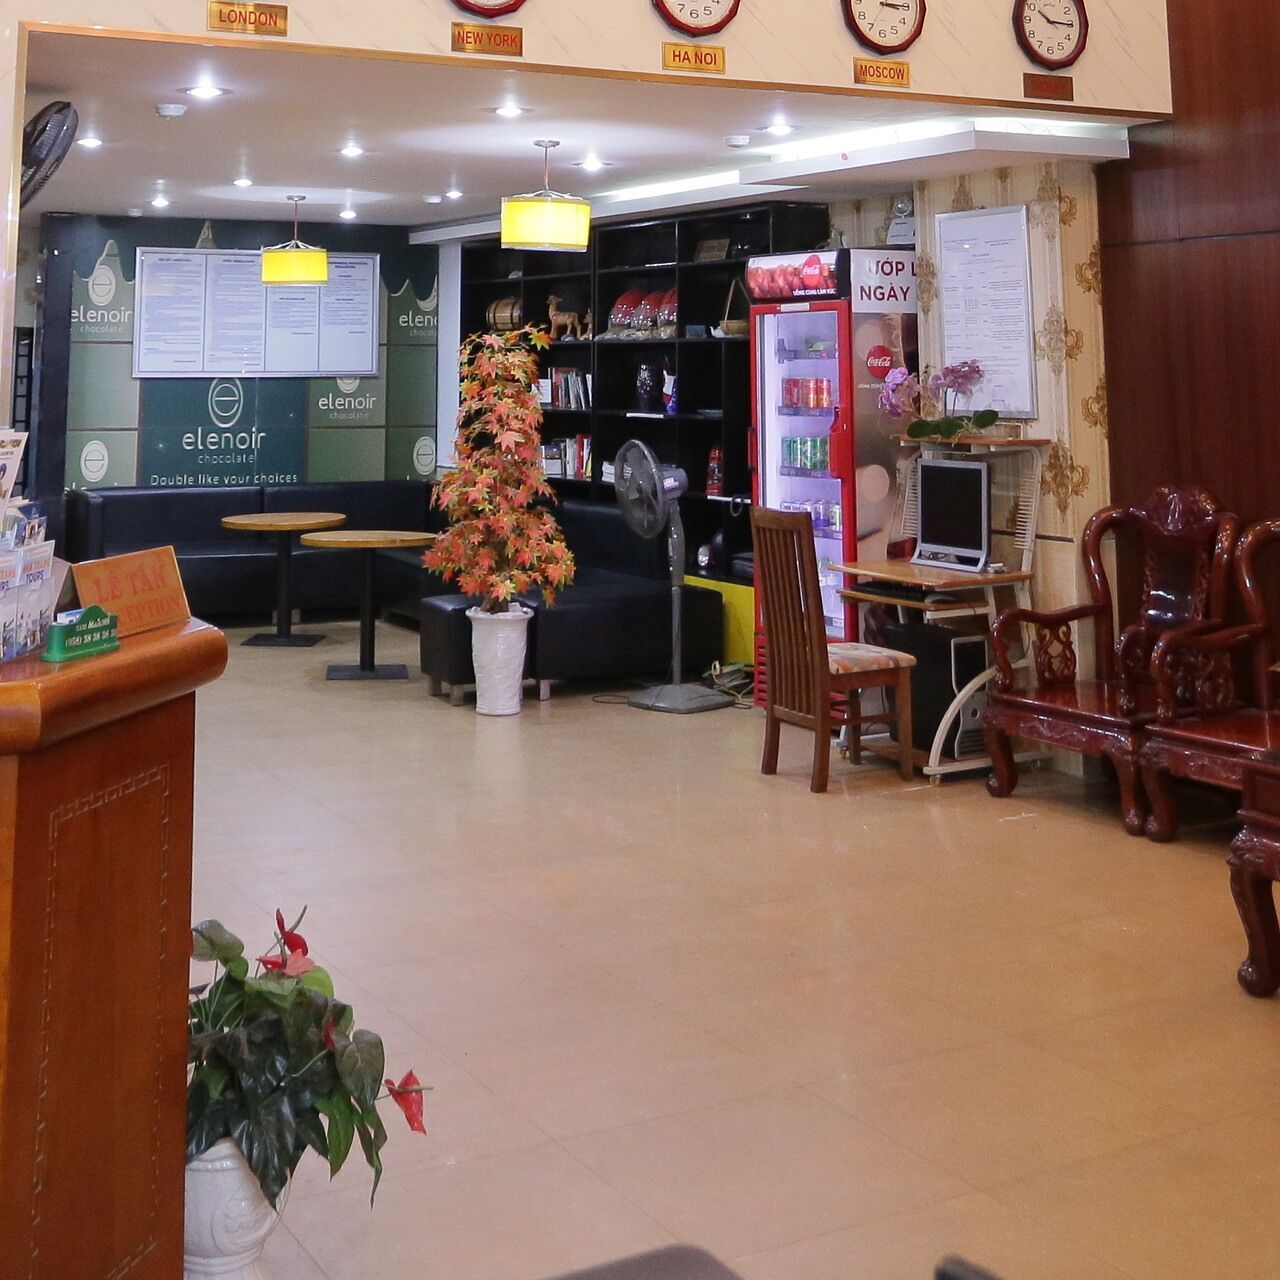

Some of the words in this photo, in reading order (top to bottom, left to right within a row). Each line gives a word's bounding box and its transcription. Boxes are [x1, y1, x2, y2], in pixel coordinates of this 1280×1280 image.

[678, 4, 685, 12] 7
[704, 6, 712, 15] 5
[1027, 3, 1035, 11] 10
[1064, 7, 1070, 15] 2
[219, 9, 278, 27] LONDON
[690, 10, 699, 18] 6
[858, 12, 865, 20] 8
[1024, 15, 1031, 23] 9
[867, 23, 874, 31] 7
[891, 26, 898, 34] 5
[879, 30, 886, 38] 6
[1028, 30, 1035, 38] 8
[457, 31, 482, 45] NEW
[487, 33, 518, 48] YORK
[1037, 40, 1043, 49] 7
[1057, 42, 1064, 50] 5
[673, 50, 691, 64] HA
[695, 51, 716, 65] NOI
[860, 64, 905, 80] MOSCOW
[860, 282, 910, 301] NGÀY
[71, 305, 132, 323] elenoir
[318, 393, 376, 409] elenoir
[182, 426, 266, 450] elenoir
[198, 453, 254, 464] chocolate
[151, 474, 194, 485] Double
[198, 474, 219, 485] like
[223, 475, 250, 485] your
[254, 473, 297, 484] choices
